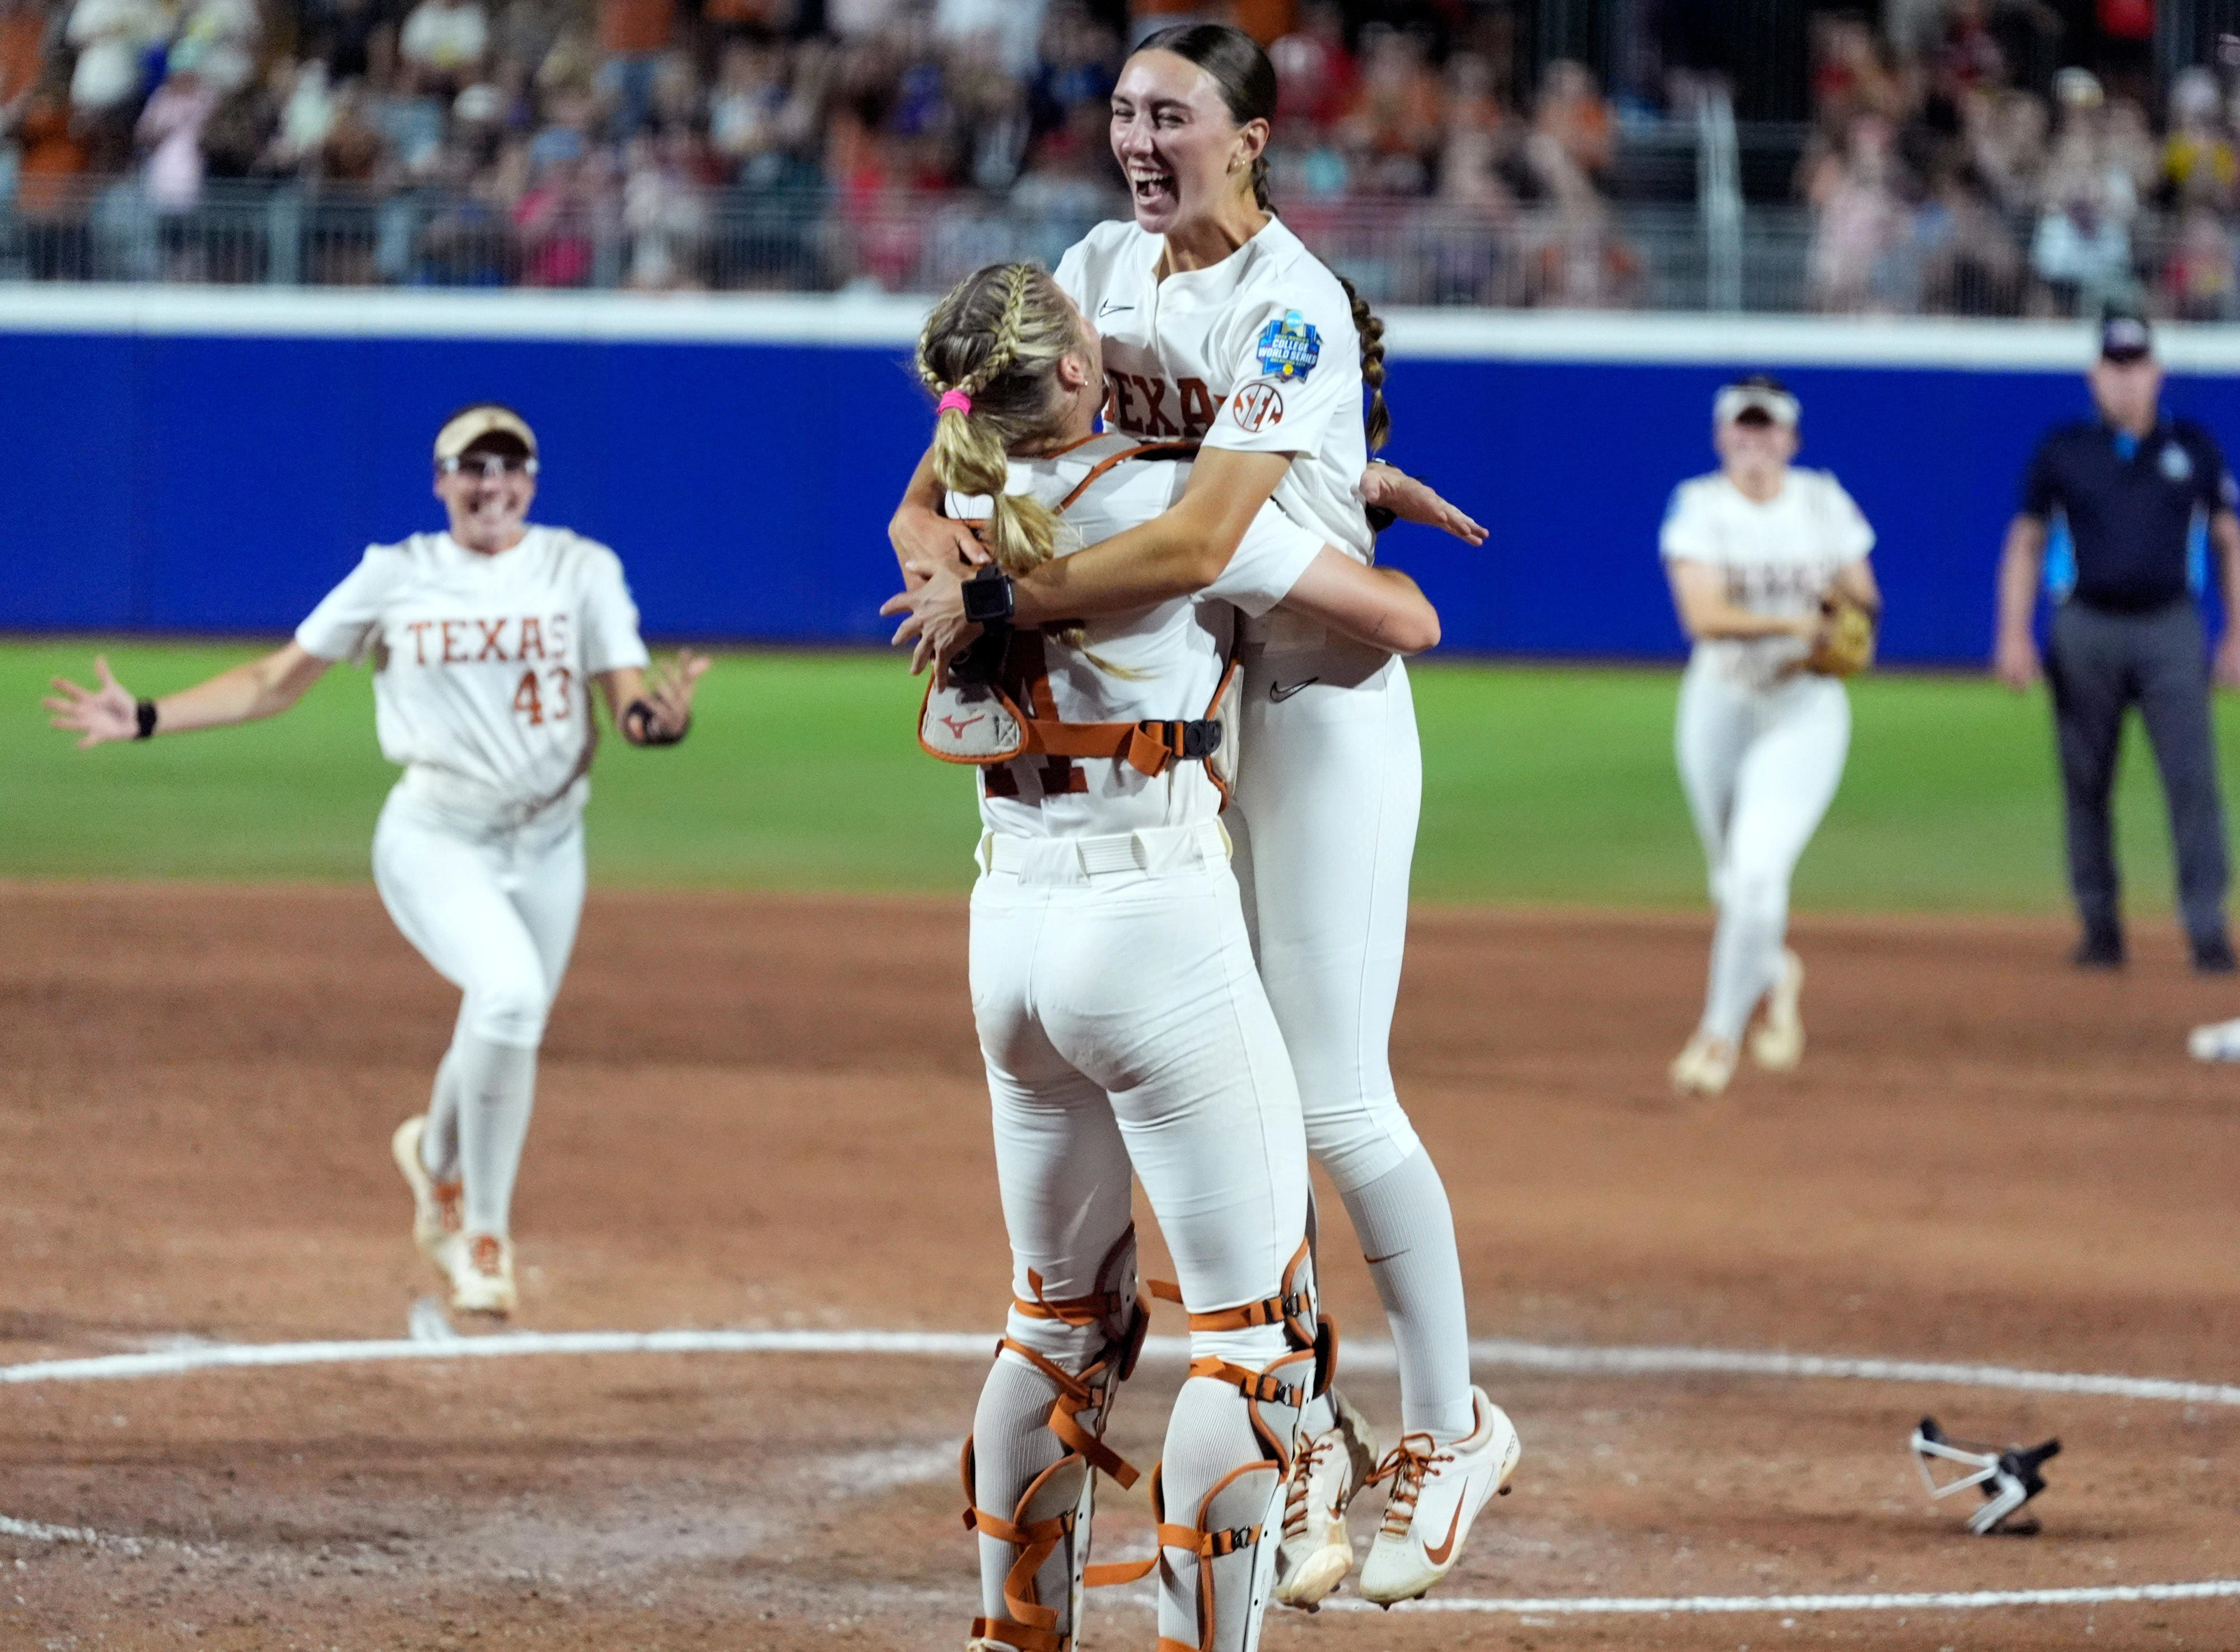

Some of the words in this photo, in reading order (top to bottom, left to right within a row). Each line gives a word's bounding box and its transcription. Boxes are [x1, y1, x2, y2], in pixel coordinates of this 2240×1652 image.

[1258, 347, 1289, 359] WORLD
[1234, 384, 1283, 432] SEC
[408, 613, 568, 665] TEXAS
[512, 666, 571, 725] 43
